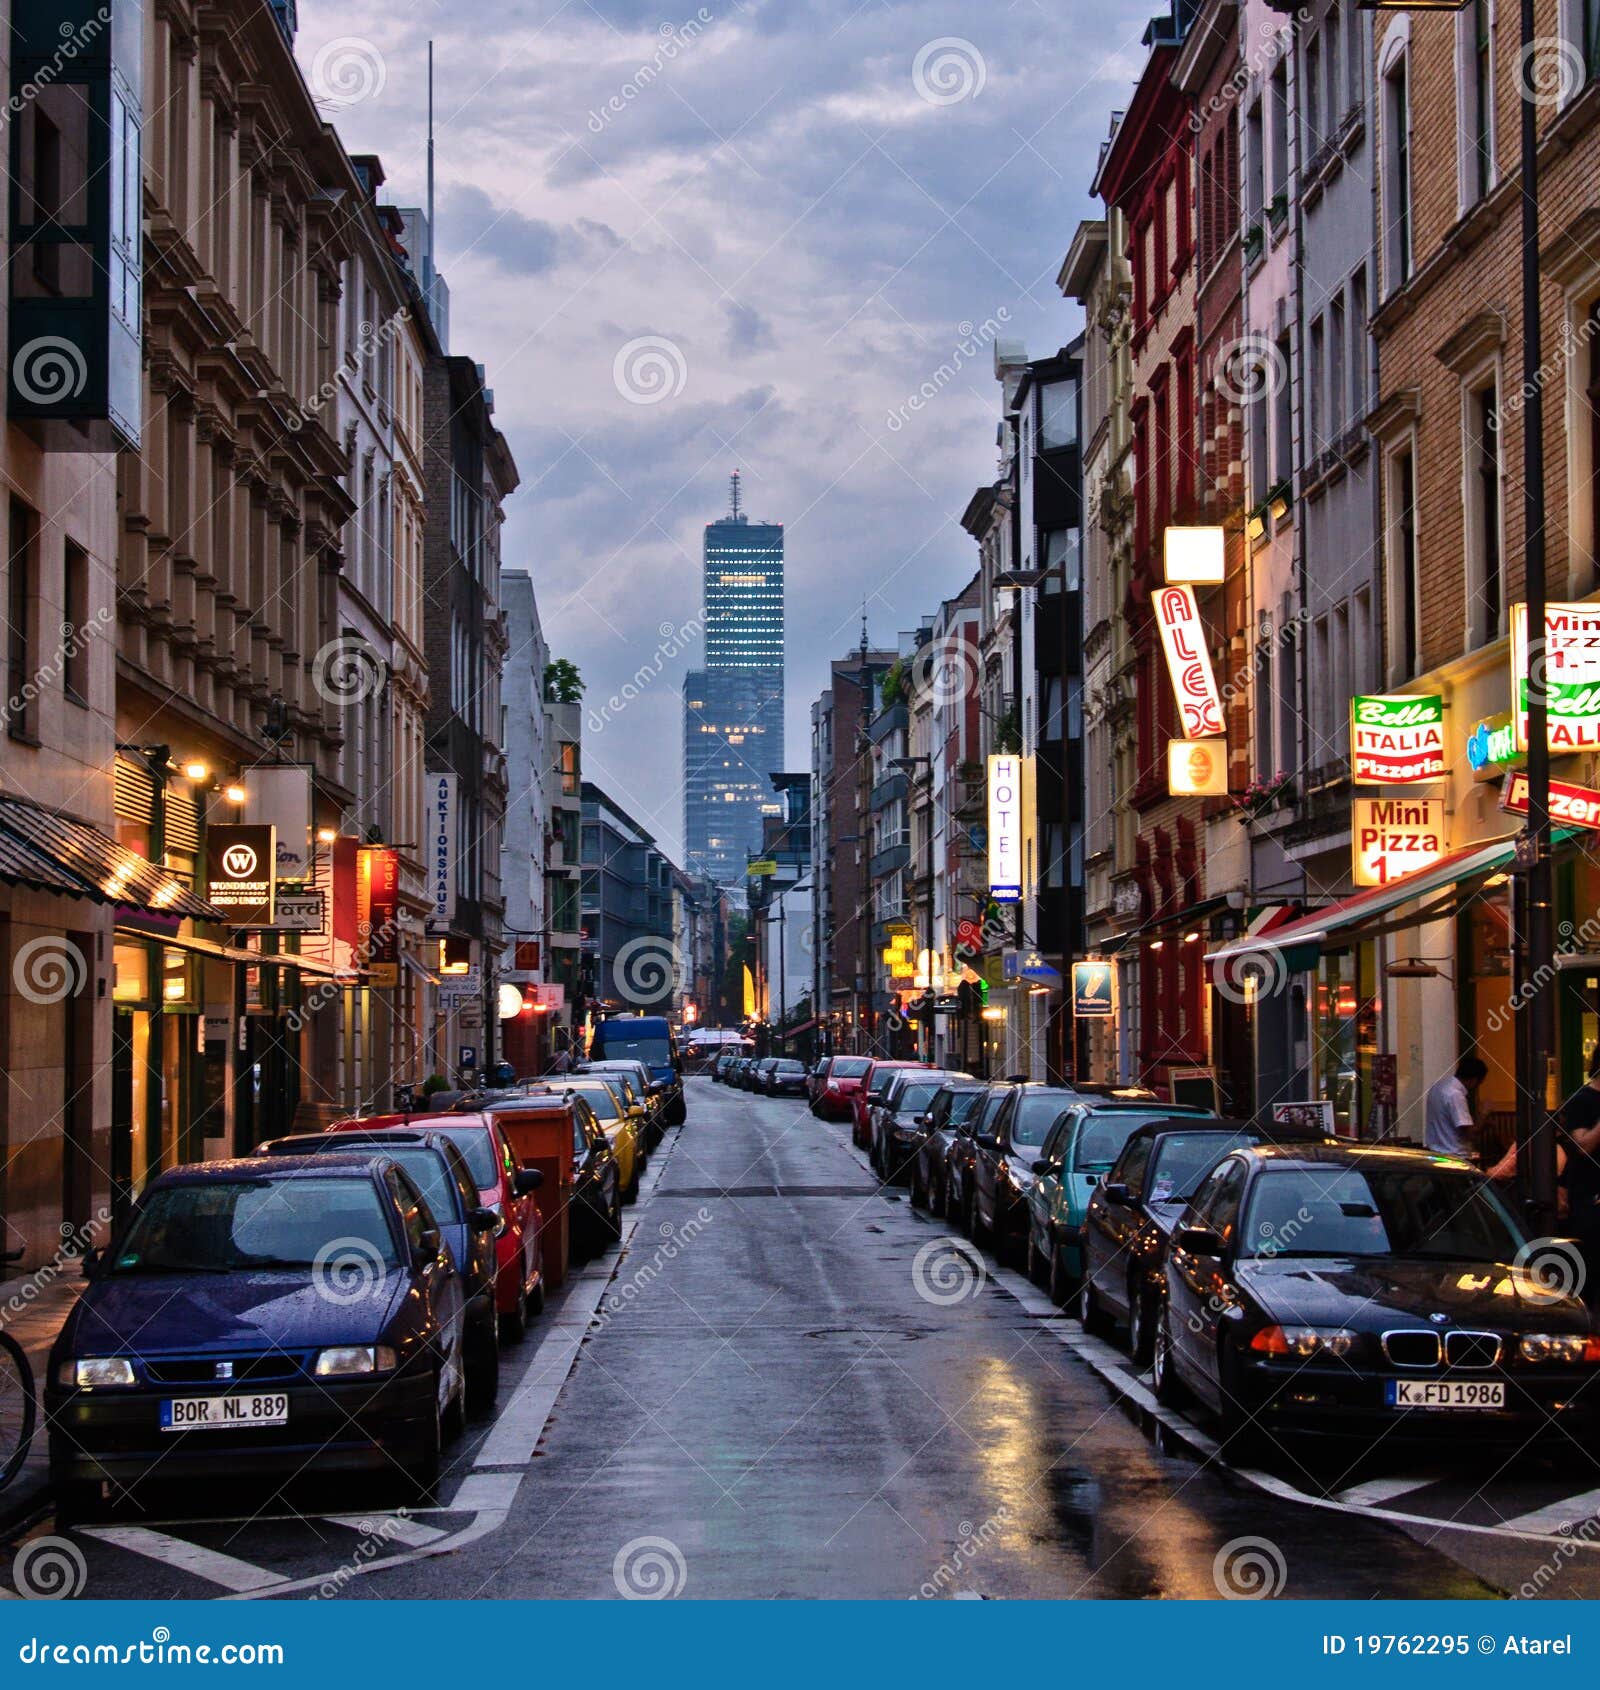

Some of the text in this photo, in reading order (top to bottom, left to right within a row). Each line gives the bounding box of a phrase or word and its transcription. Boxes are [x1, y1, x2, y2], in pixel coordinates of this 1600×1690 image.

[1551, 633, 1600, 648] izz
[1161, 587, 1221, 737] ALEX
[1357, 702, 1438, 726] Bella
[1357, 729, 1441, 750] ITALIA
[1357, 758, 1443, 778] Pizzeria
[996, 761, 1012, 878] HOTEL
[1371, 801, 1429, 825] Mini
[437, 778, 448, 914] AUKTIONSHAUS
[1361, 828, 1438, 851] Pizza
[228, 853, 252, 870] W
[462, 1050, 473, 1062] P
[1399, 1384, 1502, 1404] K FD 1986
[173, 1395, 286, 1423] BOR NL 889
